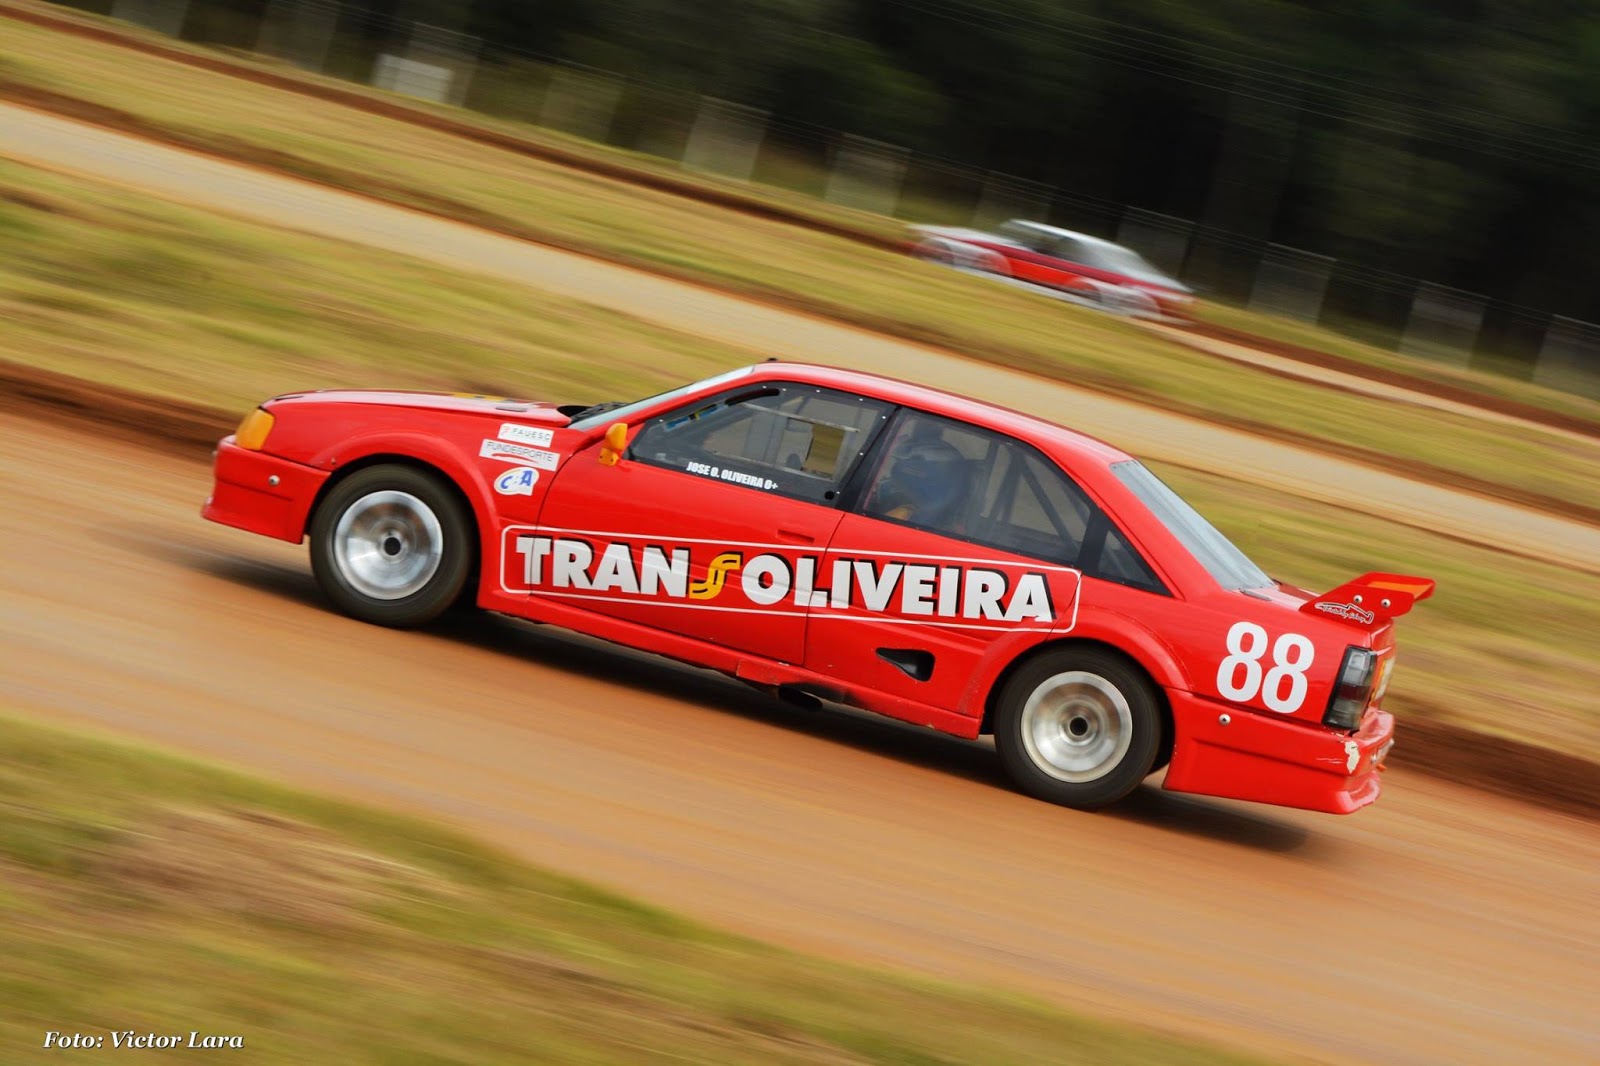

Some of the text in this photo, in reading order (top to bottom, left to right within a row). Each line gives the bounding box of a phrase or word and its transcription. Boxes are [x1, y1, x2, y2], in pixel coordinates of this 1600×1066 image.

[512, 428, 551, 441] FAUESC
[486, 441, 554, 462] FUNDESPORTE
[686, 461, 711, 475] JOSE
[721, 469, 764, 488] OLIVEIRA
[1216, 621, 1315, 714] 88
